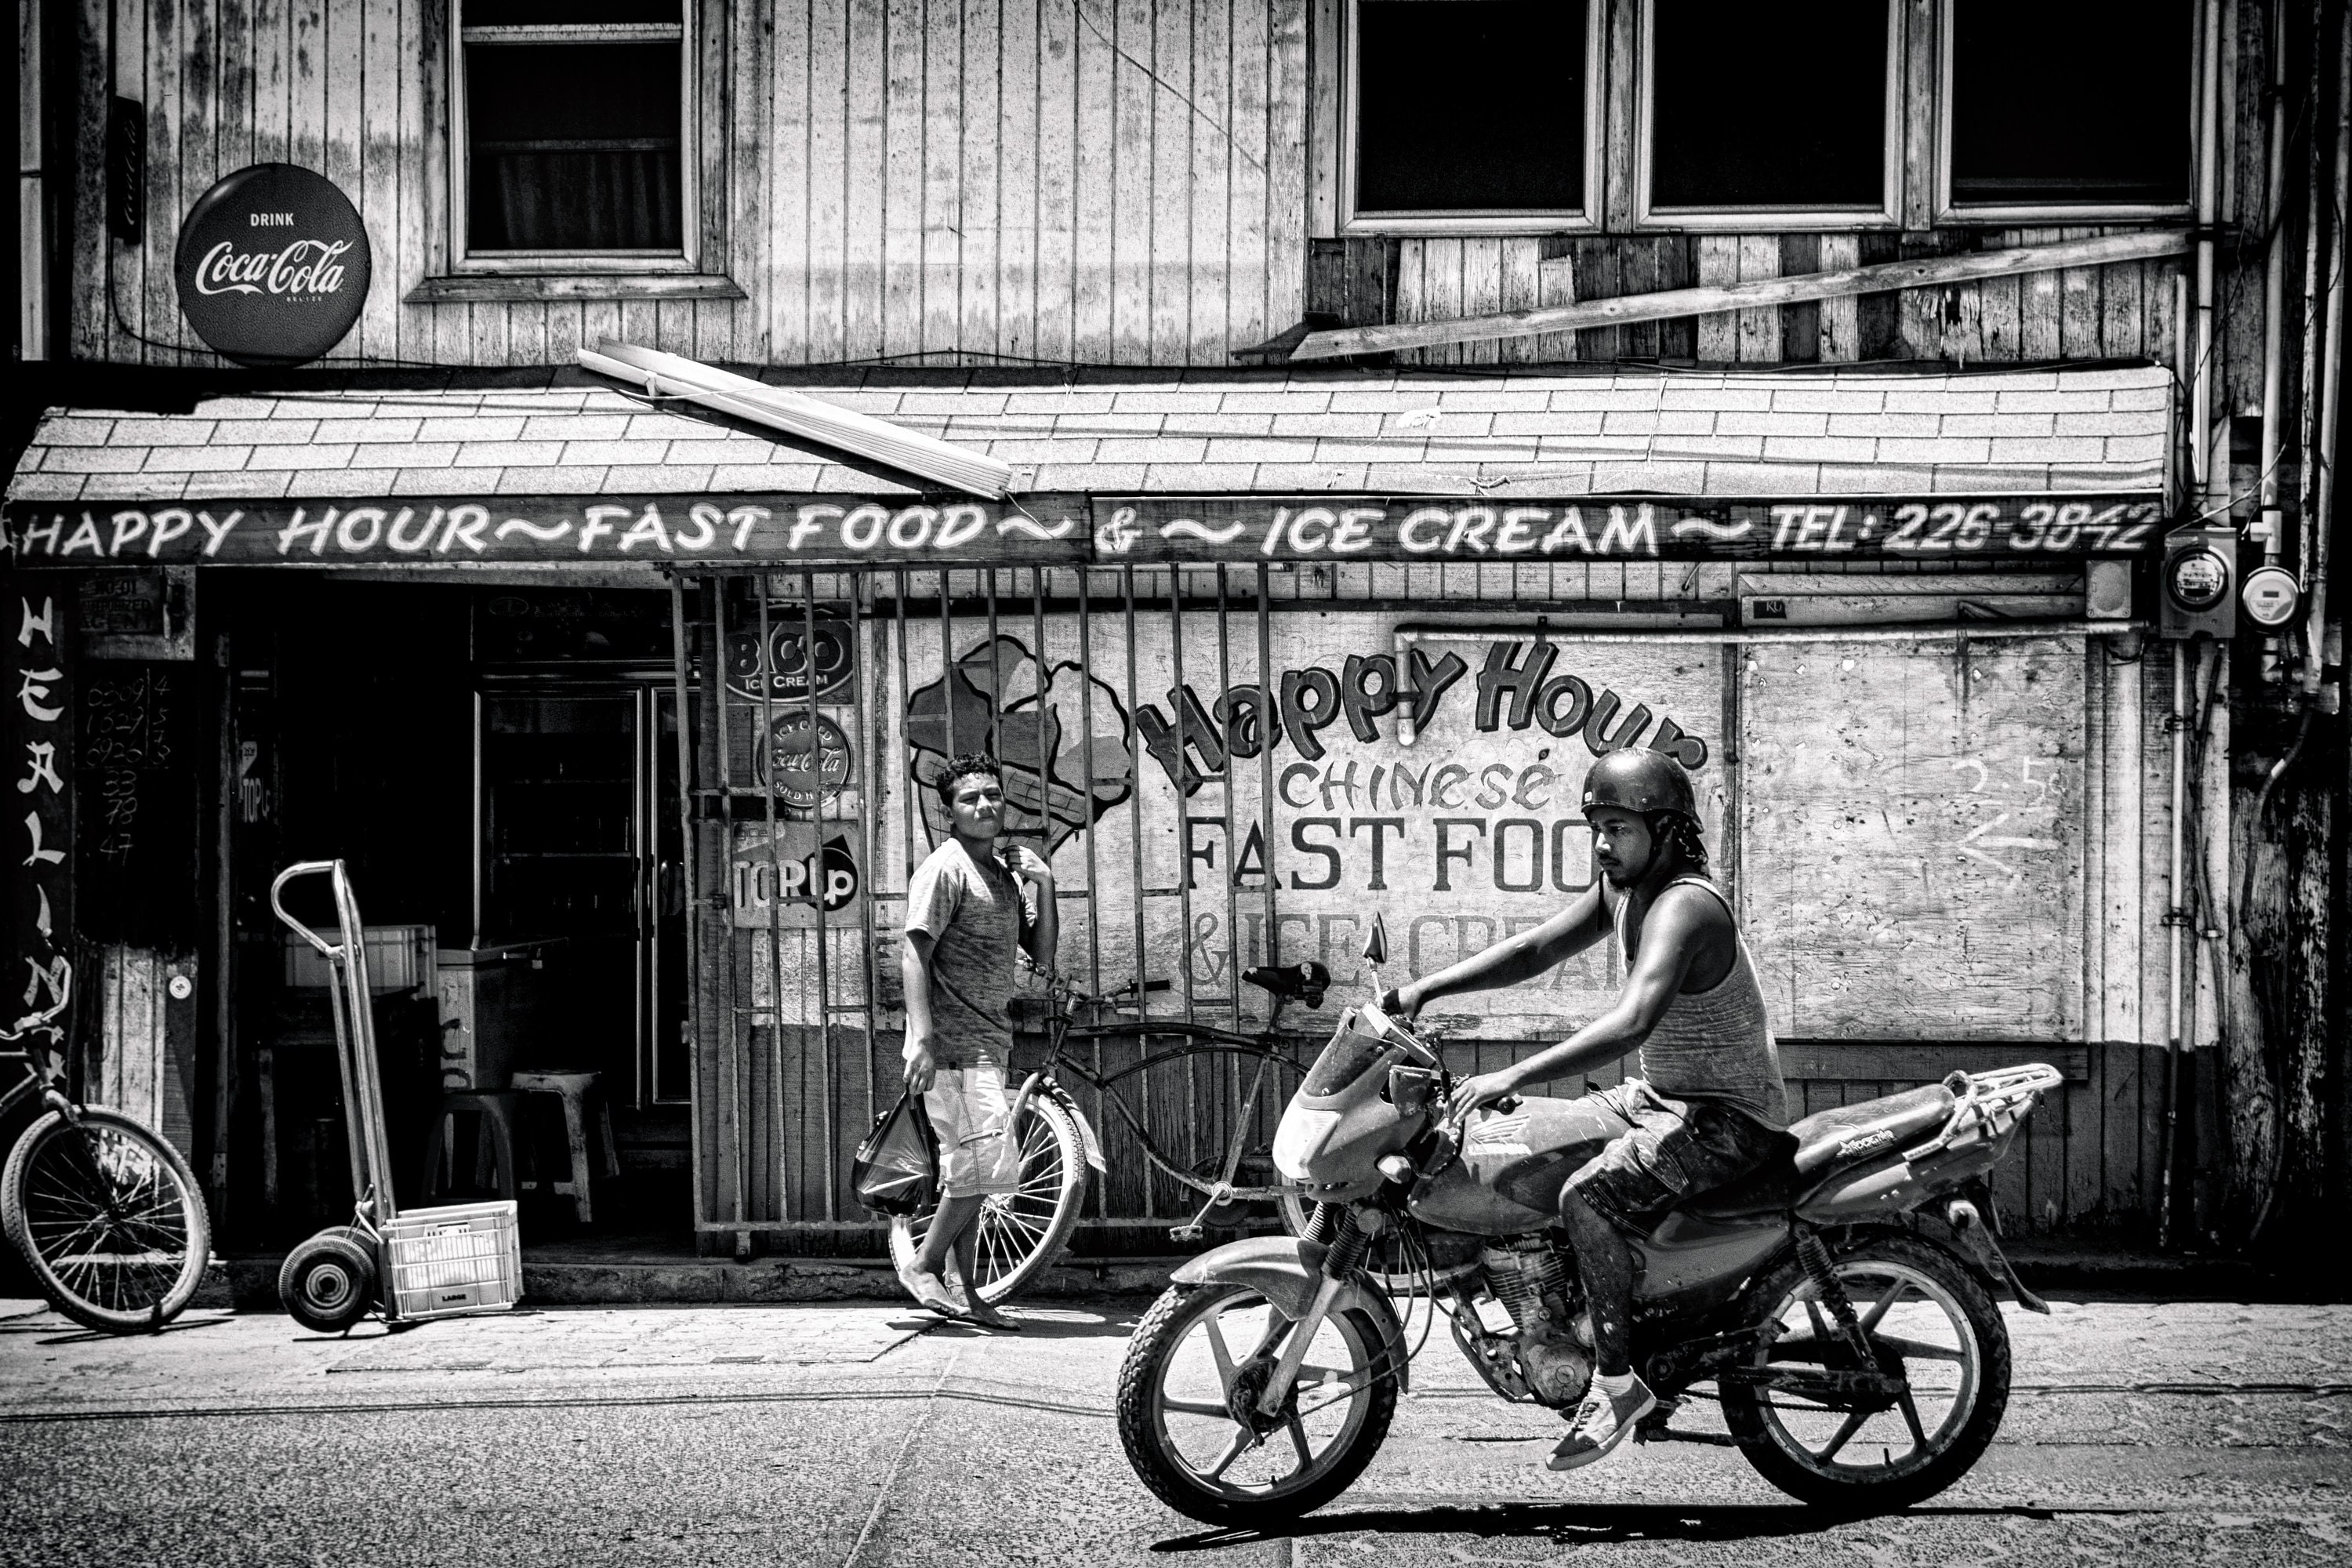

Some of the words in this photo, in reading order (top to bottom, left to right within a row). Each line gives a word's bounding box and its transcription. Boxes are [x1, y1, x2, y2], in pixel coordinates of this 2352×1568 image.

[250, 212, 295, 227] DRINK
[195, 239, 354, 296] Coca-Cola
[22, 506, 245, 558] HAPPY
[277, 504, 491, 557] HOUR
[577, 502, 770, 554] FAST
[786, 502, 986, 551] FOOD
[1094, 506, 1142, 555] &
[1260, 505, 1387, 557] ICE
[1397, 502, 1660, 557] CREAM
[1769, 504, 1878, 551] TEL:
[1882, 502, 2162, 550] 226-3842
[1136, 648, 1468, 798] Happy
[1475, 641, 1708, 770] Hour
[99, 833, 134, 866] 47
[1179, 816, 1405, 891] FAST
[1432, 817, 1599, 892] FOO
[441, 1294, 466, 1302] LARGE
